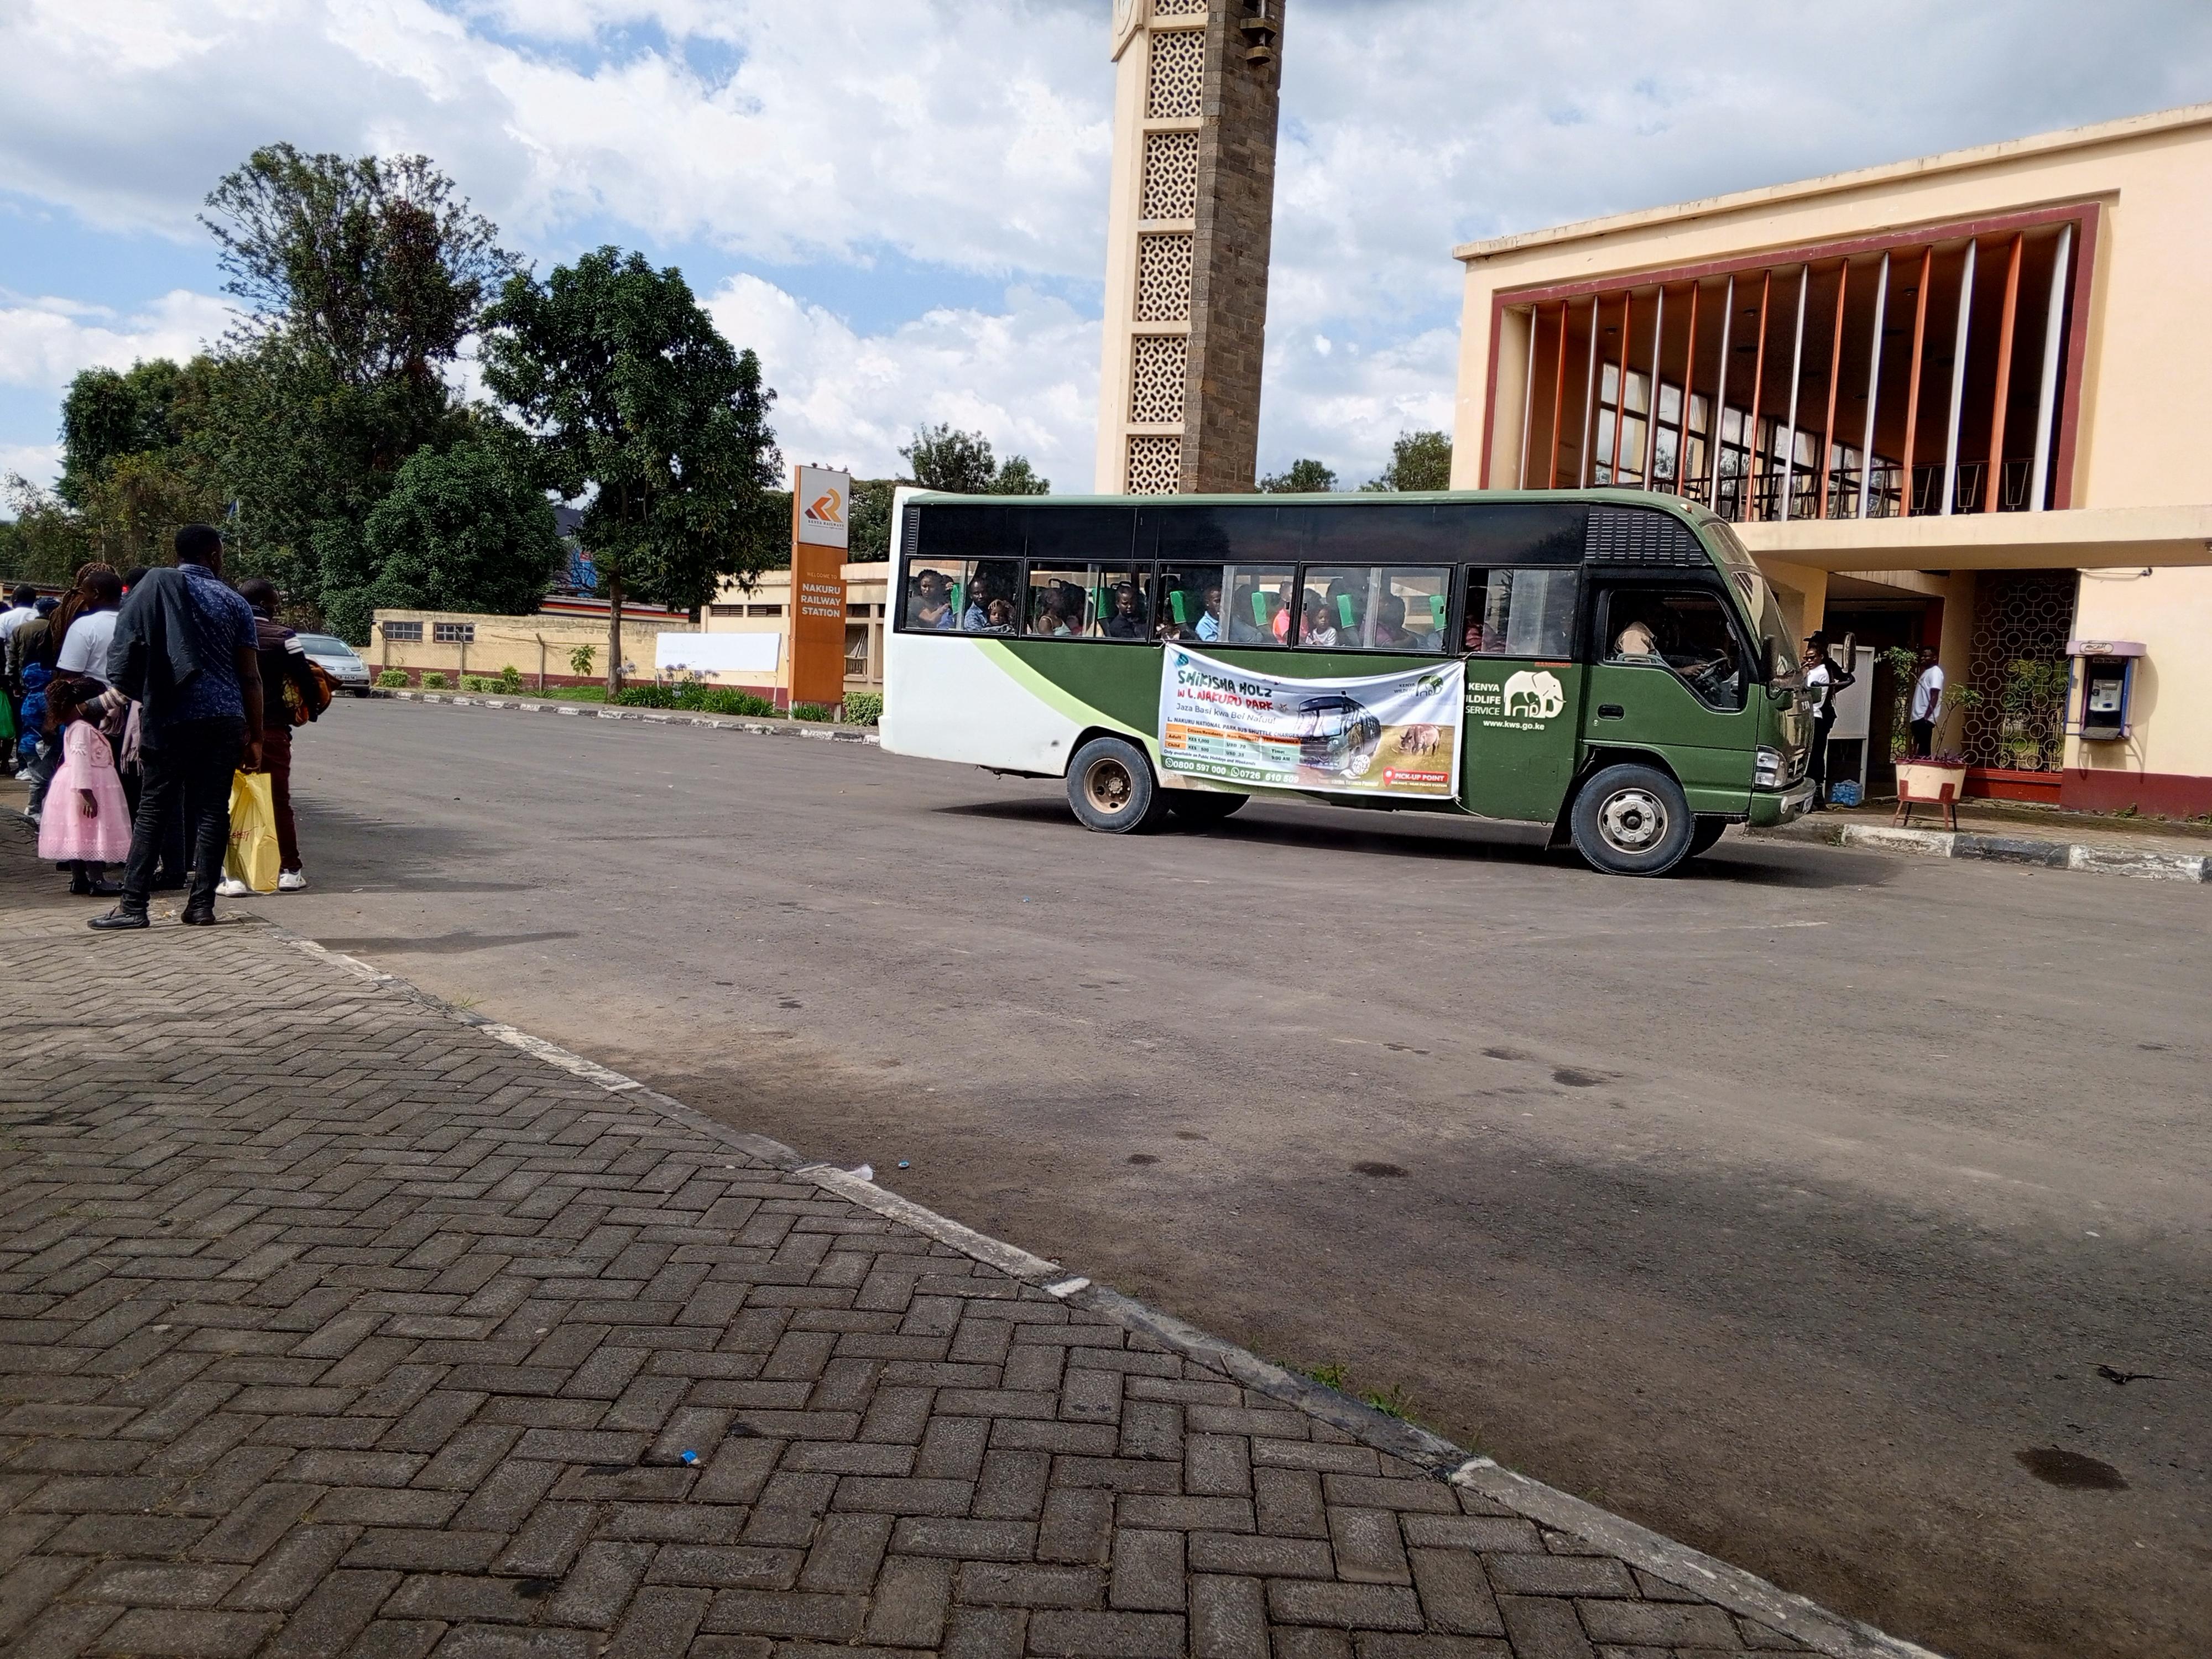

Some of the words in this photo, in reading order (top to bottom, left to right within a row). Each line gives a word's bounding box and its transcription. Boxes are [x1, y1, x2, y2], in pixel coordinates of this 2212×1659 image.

[802, 583, 841, 594] NAKURU
[801, 594, 841, 606] RAILWAY
[802, 607, 841, 618] STATION
[1468, 682, 1500, 692] KENYA
[1245, 698, 1274, 711] PARK
[1465, 695, 1501, 705] ILDLIFE
[1176, 703, 1193, 712] Jaza
[1195, 706, 1212, 714] Basi
[1214, 708, 1229, 718] kwa
[1231, 712, 1245, 720] Bei
[1465, 705, 1500, 716] SERVICE
[1196, 719, 1221, 728] NATIONAL
[1248, 728, 1272, 736] SHUTTLE
[1483, 720, 1545, 731] www.kws.go.ke
[1173, 760, 1194, 770] 0800
[1196, 763, 1210, 772] 597
[1212, 765, 1227, 774] 000
[1240, 770, 1261, 780] 0726
[1265, 772, 1280, 782] 610
[1282, 774, 1300, 784] 509
[1394, 773, 1422, 781] PICK-UP
